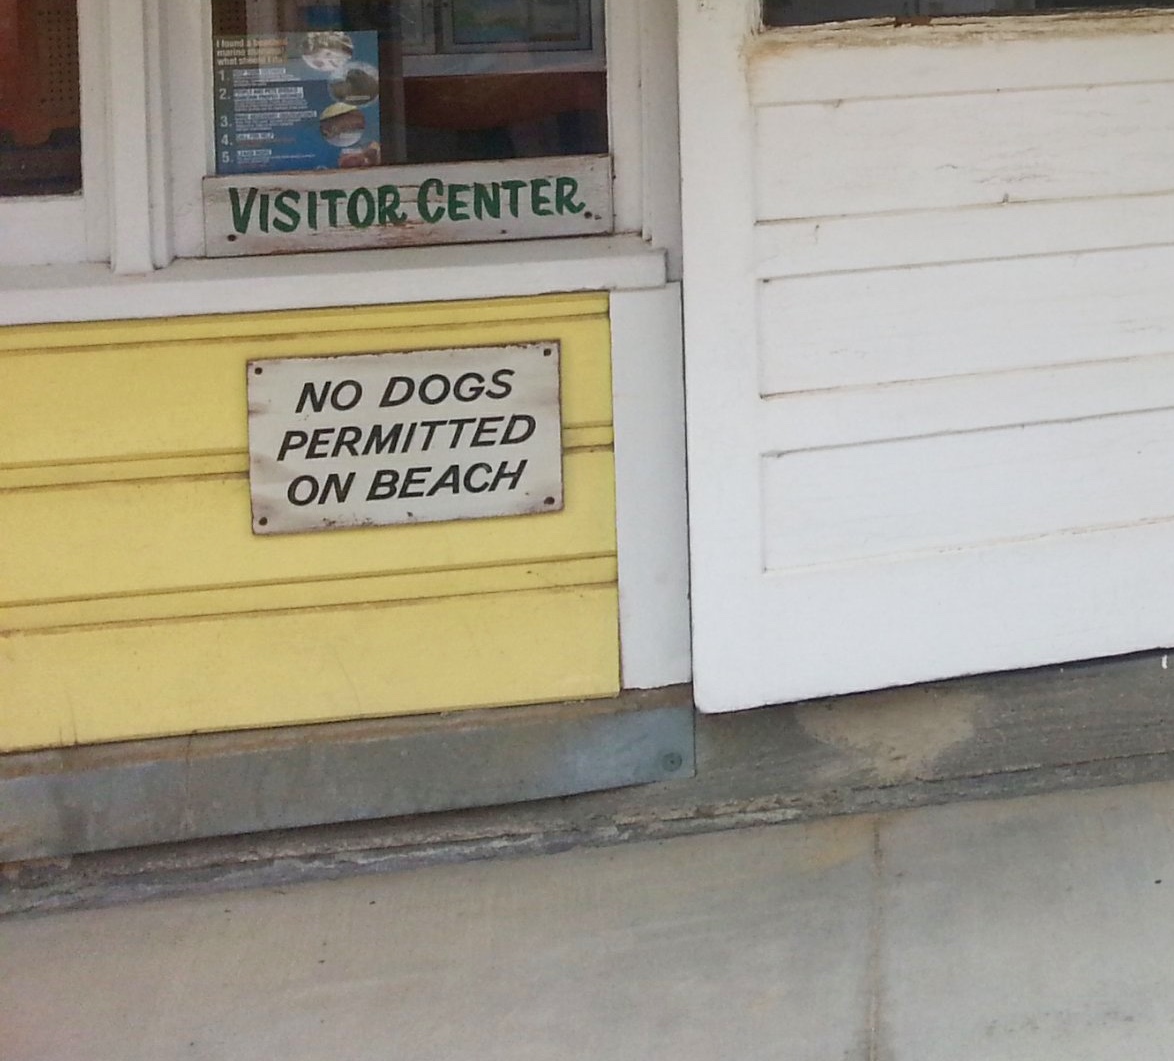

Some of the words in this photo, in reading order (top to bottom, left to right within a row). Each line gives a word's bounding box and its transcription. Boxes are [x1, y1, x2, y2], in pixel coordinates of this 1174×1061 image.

[217, 56, 238, 66] what
[219, 87, 231, 100] 2.
[220, 115, 232, 128] 3.
[220, 133, 232, 146] 4.
[229, 185, 408, 234] VISITOR
[417, 177, 586, 223] CENTER
[295, 379, 363, 414] NO
[379, 369, 515, 408] DOGS
[277, 414, 536, 461] PERMITTED
[287, 471, 356, 506] ON
[366, 459, 528, 501] BEACH
